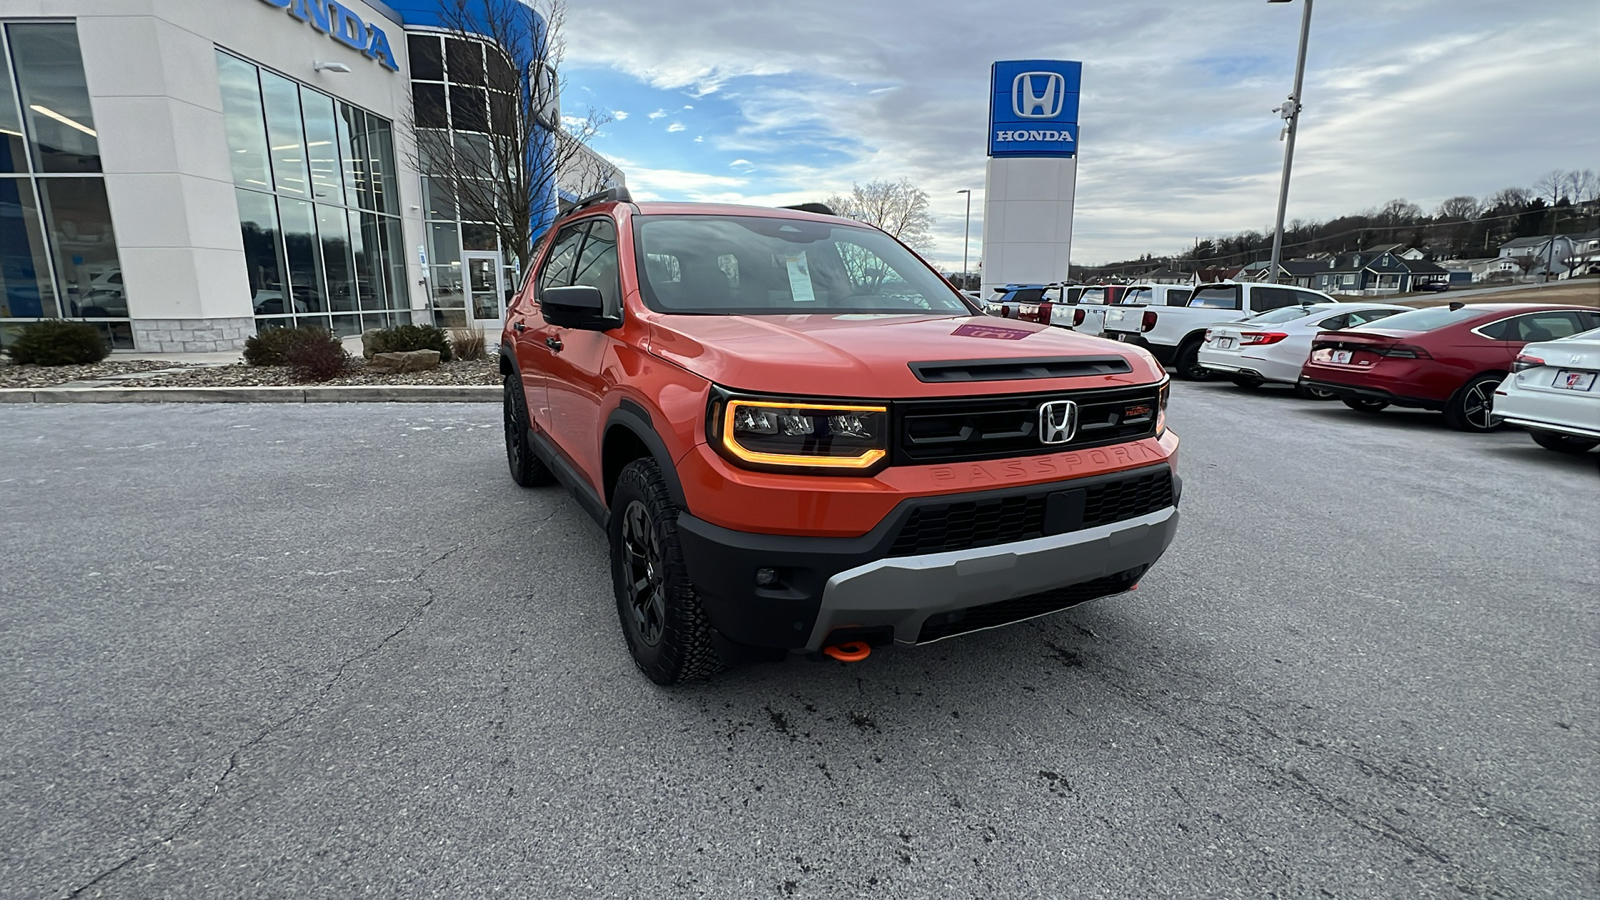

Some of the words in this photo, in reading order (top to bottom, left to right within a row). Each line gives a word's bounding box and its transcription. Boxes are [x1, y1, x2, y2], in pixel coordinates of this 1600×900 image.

[255, 0, 399, 71] NDA
[996, 130, 1074, 142] HONDA
[929, 442, 1161, 487] PASSPORT
